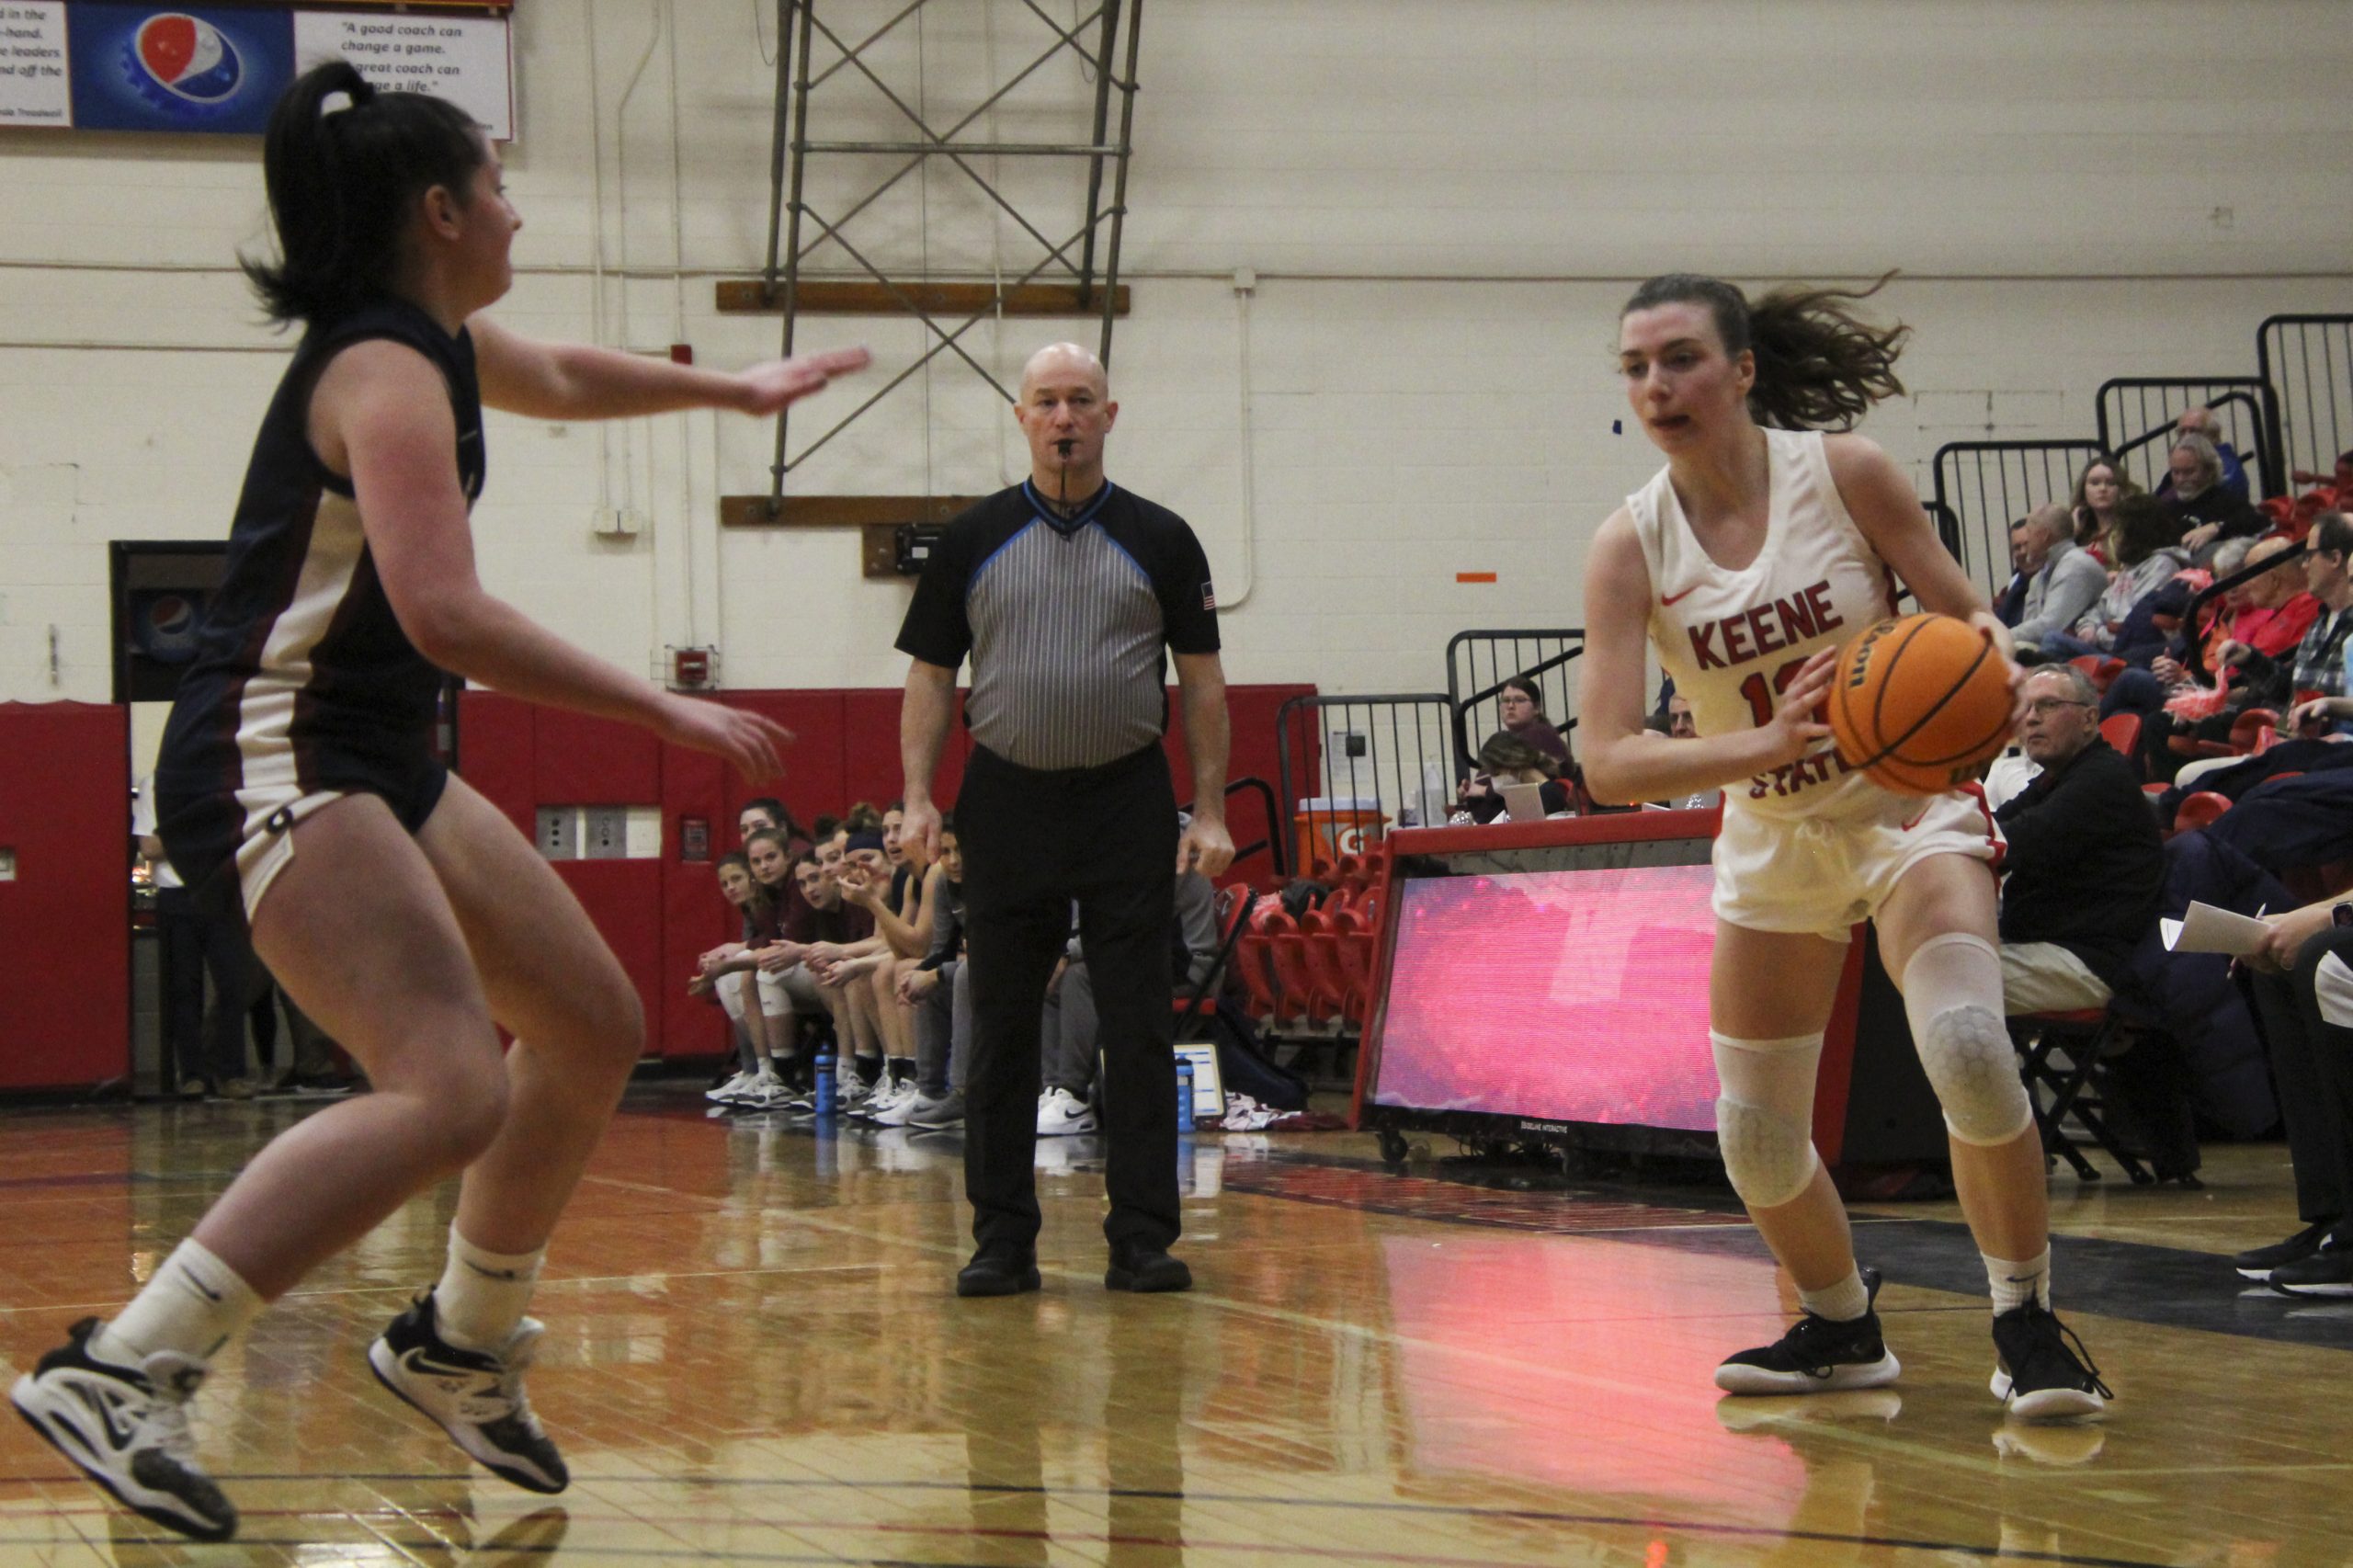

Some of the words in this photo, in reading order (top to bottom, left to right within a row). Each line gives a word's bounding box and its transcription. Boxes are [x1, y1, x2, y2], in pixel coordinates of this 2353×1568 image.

[24, 8, 46, 19] the
[360, 23, 393, 36] good
[397, 25, 436, 37] coach
[439, 28, 462, 37] can
[11, 46, 60, 57] leaders
[341, 40, 389, 53] change
[393, 44, 402, 52] a
[405, 44, 446, 55] game.
[18, 64, 37, 77] off
[40, 64, 63, 76] the
[356, 62, 392, 74] great
[395, 63, 434, 74] coach
[437, 65, 460, 74] can
[394, 81, 403, 90] a
[1688, 579, 1844, 671] KEENE
